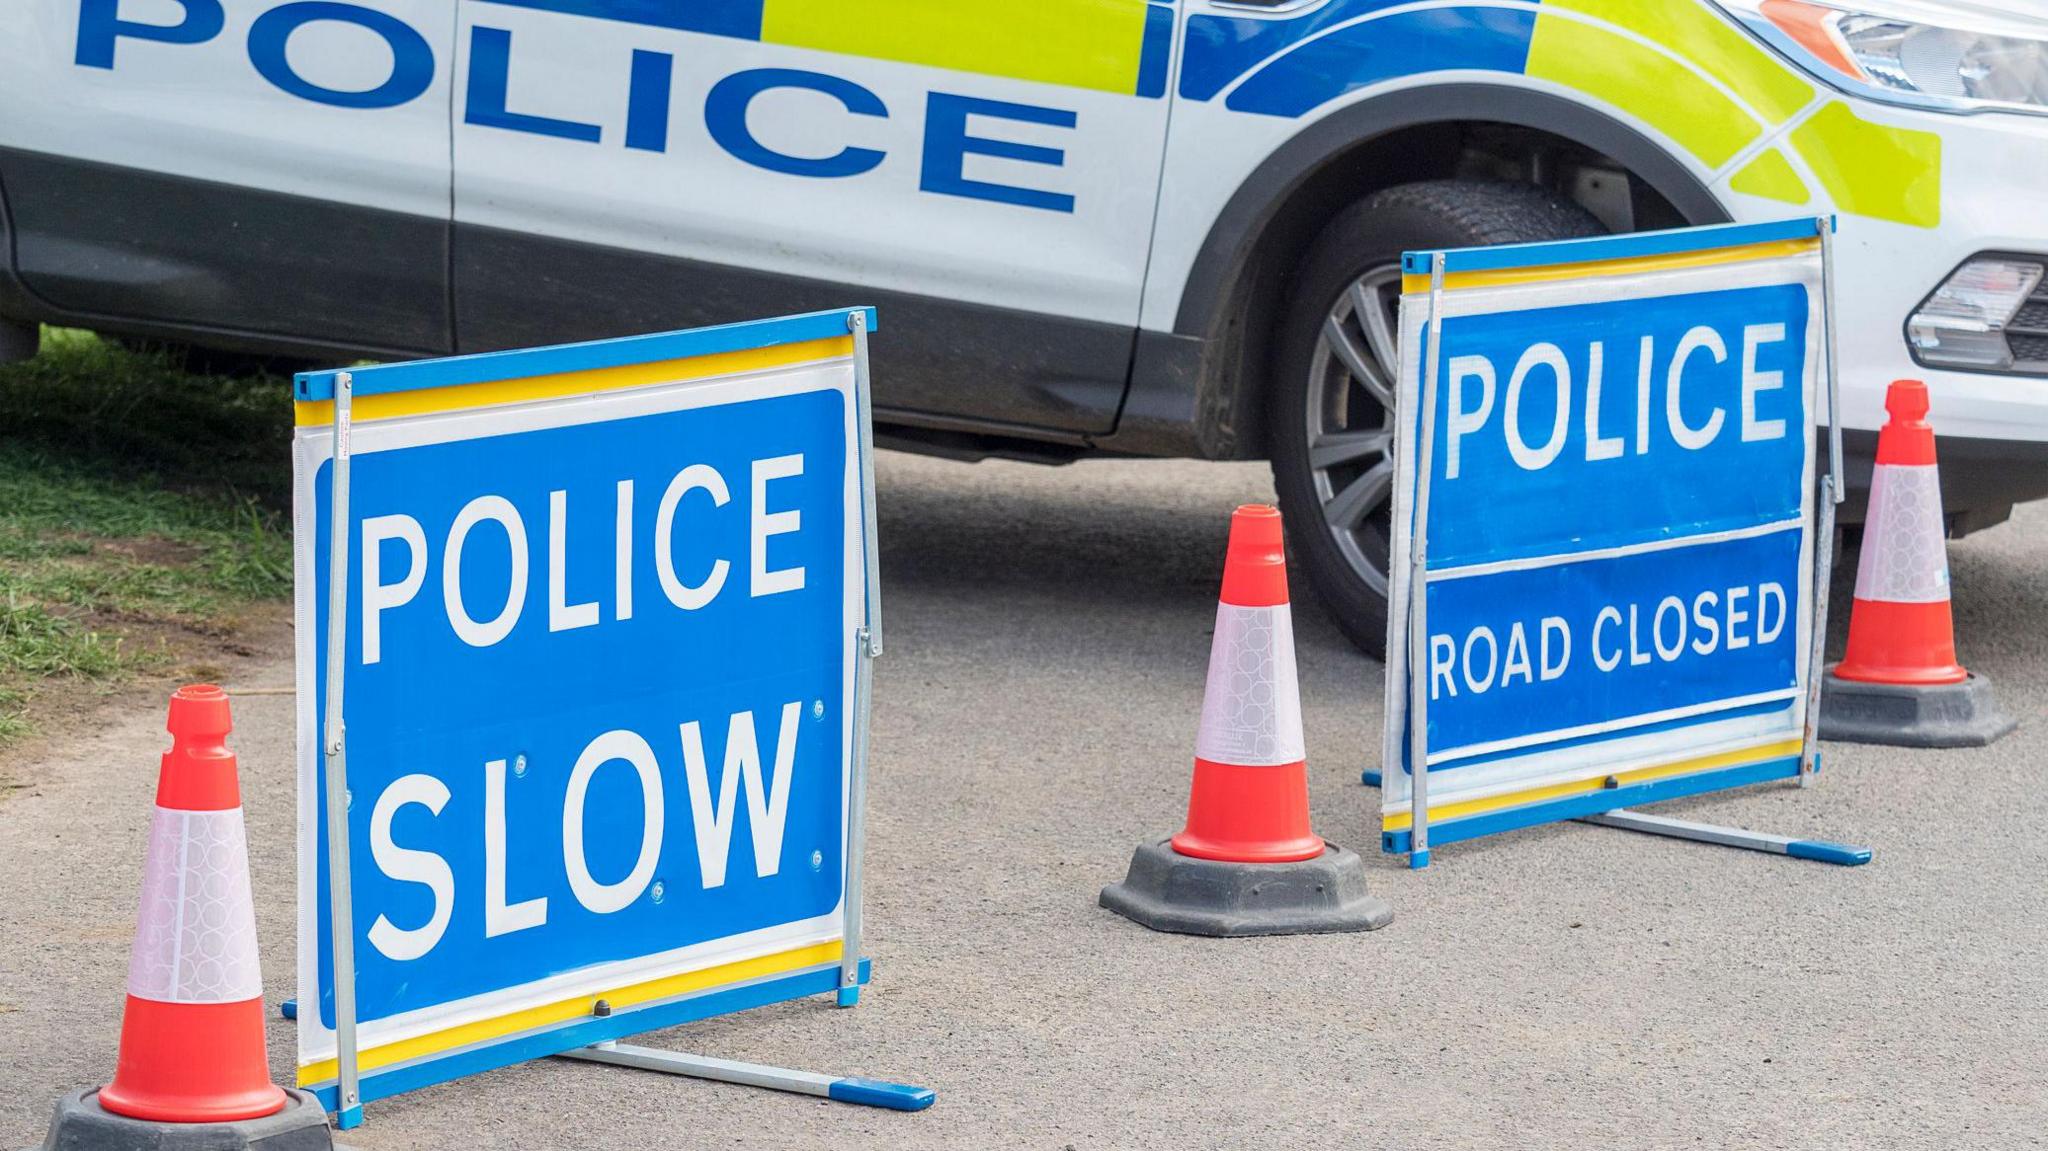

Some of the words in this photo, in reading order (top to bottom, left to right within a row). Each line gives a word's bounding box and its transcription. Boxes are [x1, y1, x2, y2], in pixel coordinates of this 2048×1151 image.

[75, 0, 1077, 213] POLICE
[1445, 322, 1787, 480] POLICE
[361, 453, 806, 665] POLICE
[1430, 616, 1571, 700] ROAD
[1592, 581, 1787, 672] CLOSED
[367, 700, 802, 960] SLOW
